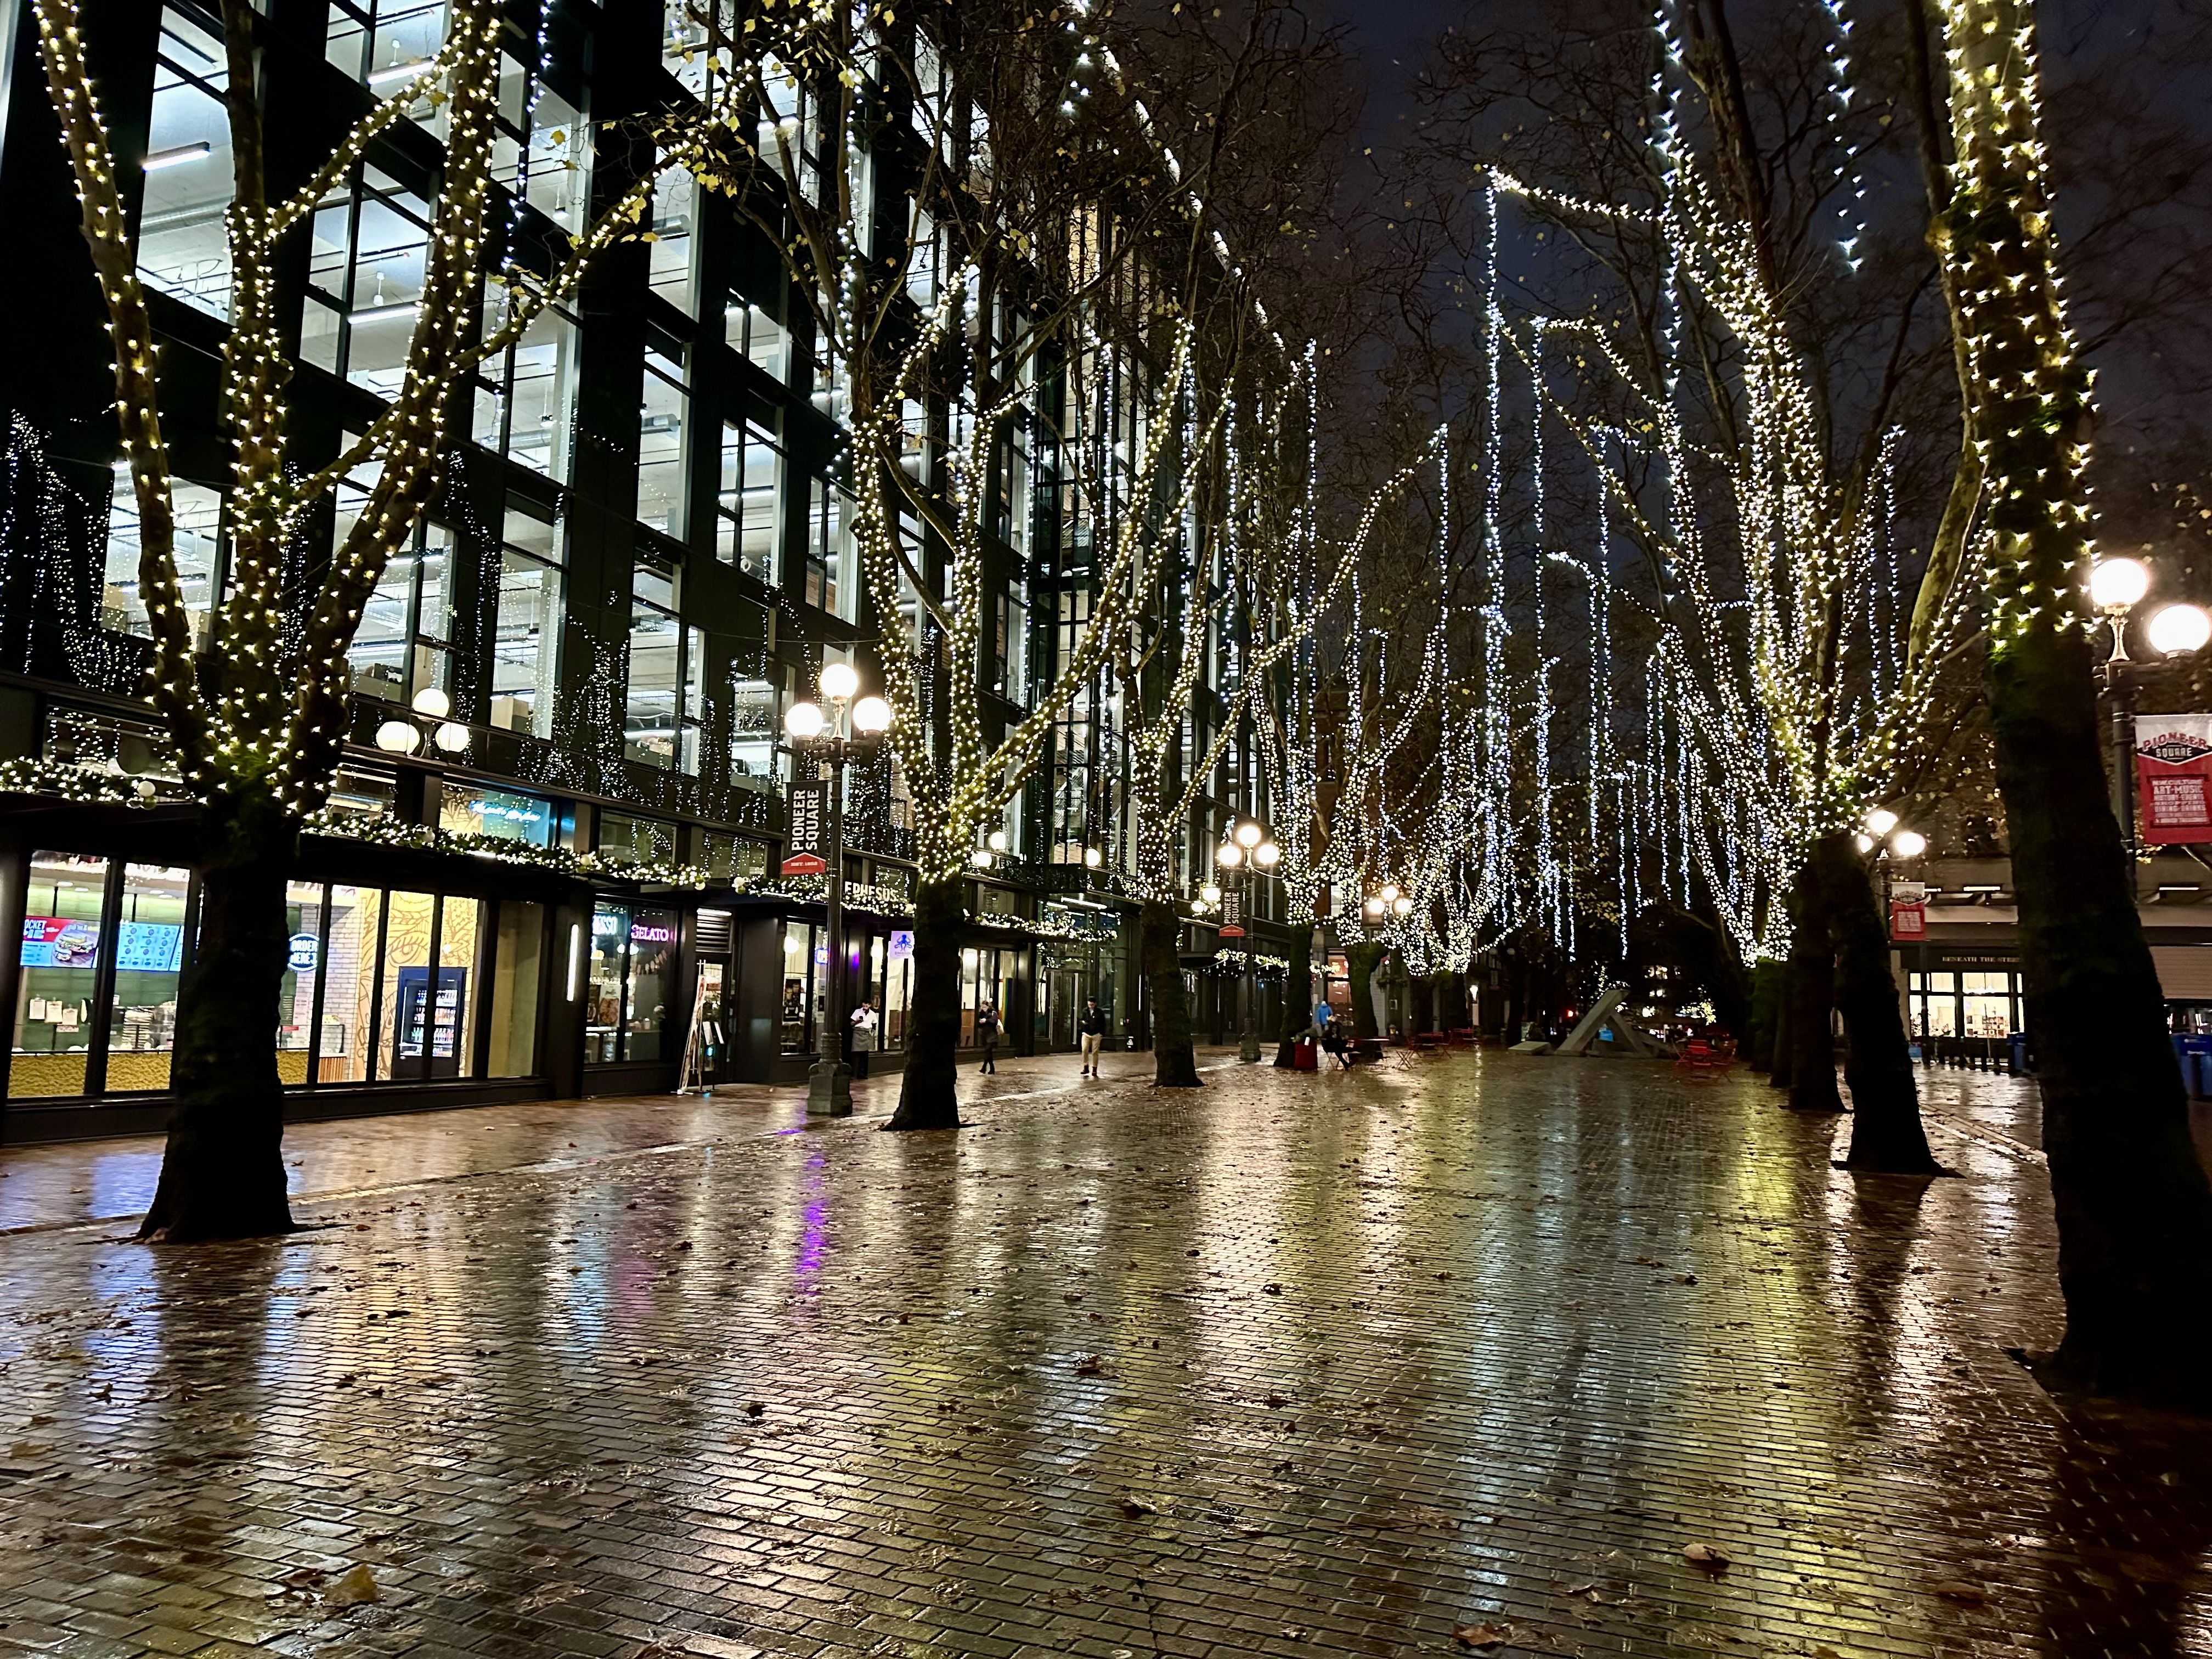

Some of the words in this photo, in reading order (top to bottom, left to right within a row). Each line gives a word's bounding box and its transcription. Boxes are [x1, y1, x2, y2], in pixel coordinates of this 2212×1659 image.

[2142, 732, 2209, 752] PIONEER
[2155, 747, 2193, 758] SQUARE
[792, 790, 805, 850] PIONEER
[805, 790, 820, 850] SQUARE
[1232, 892, 1240, 924] SQUARE
[631, 924, 669, 941] GELATO
[290, 940, 318, 952] ORDER
[290, 952, 311, 964] HERE
